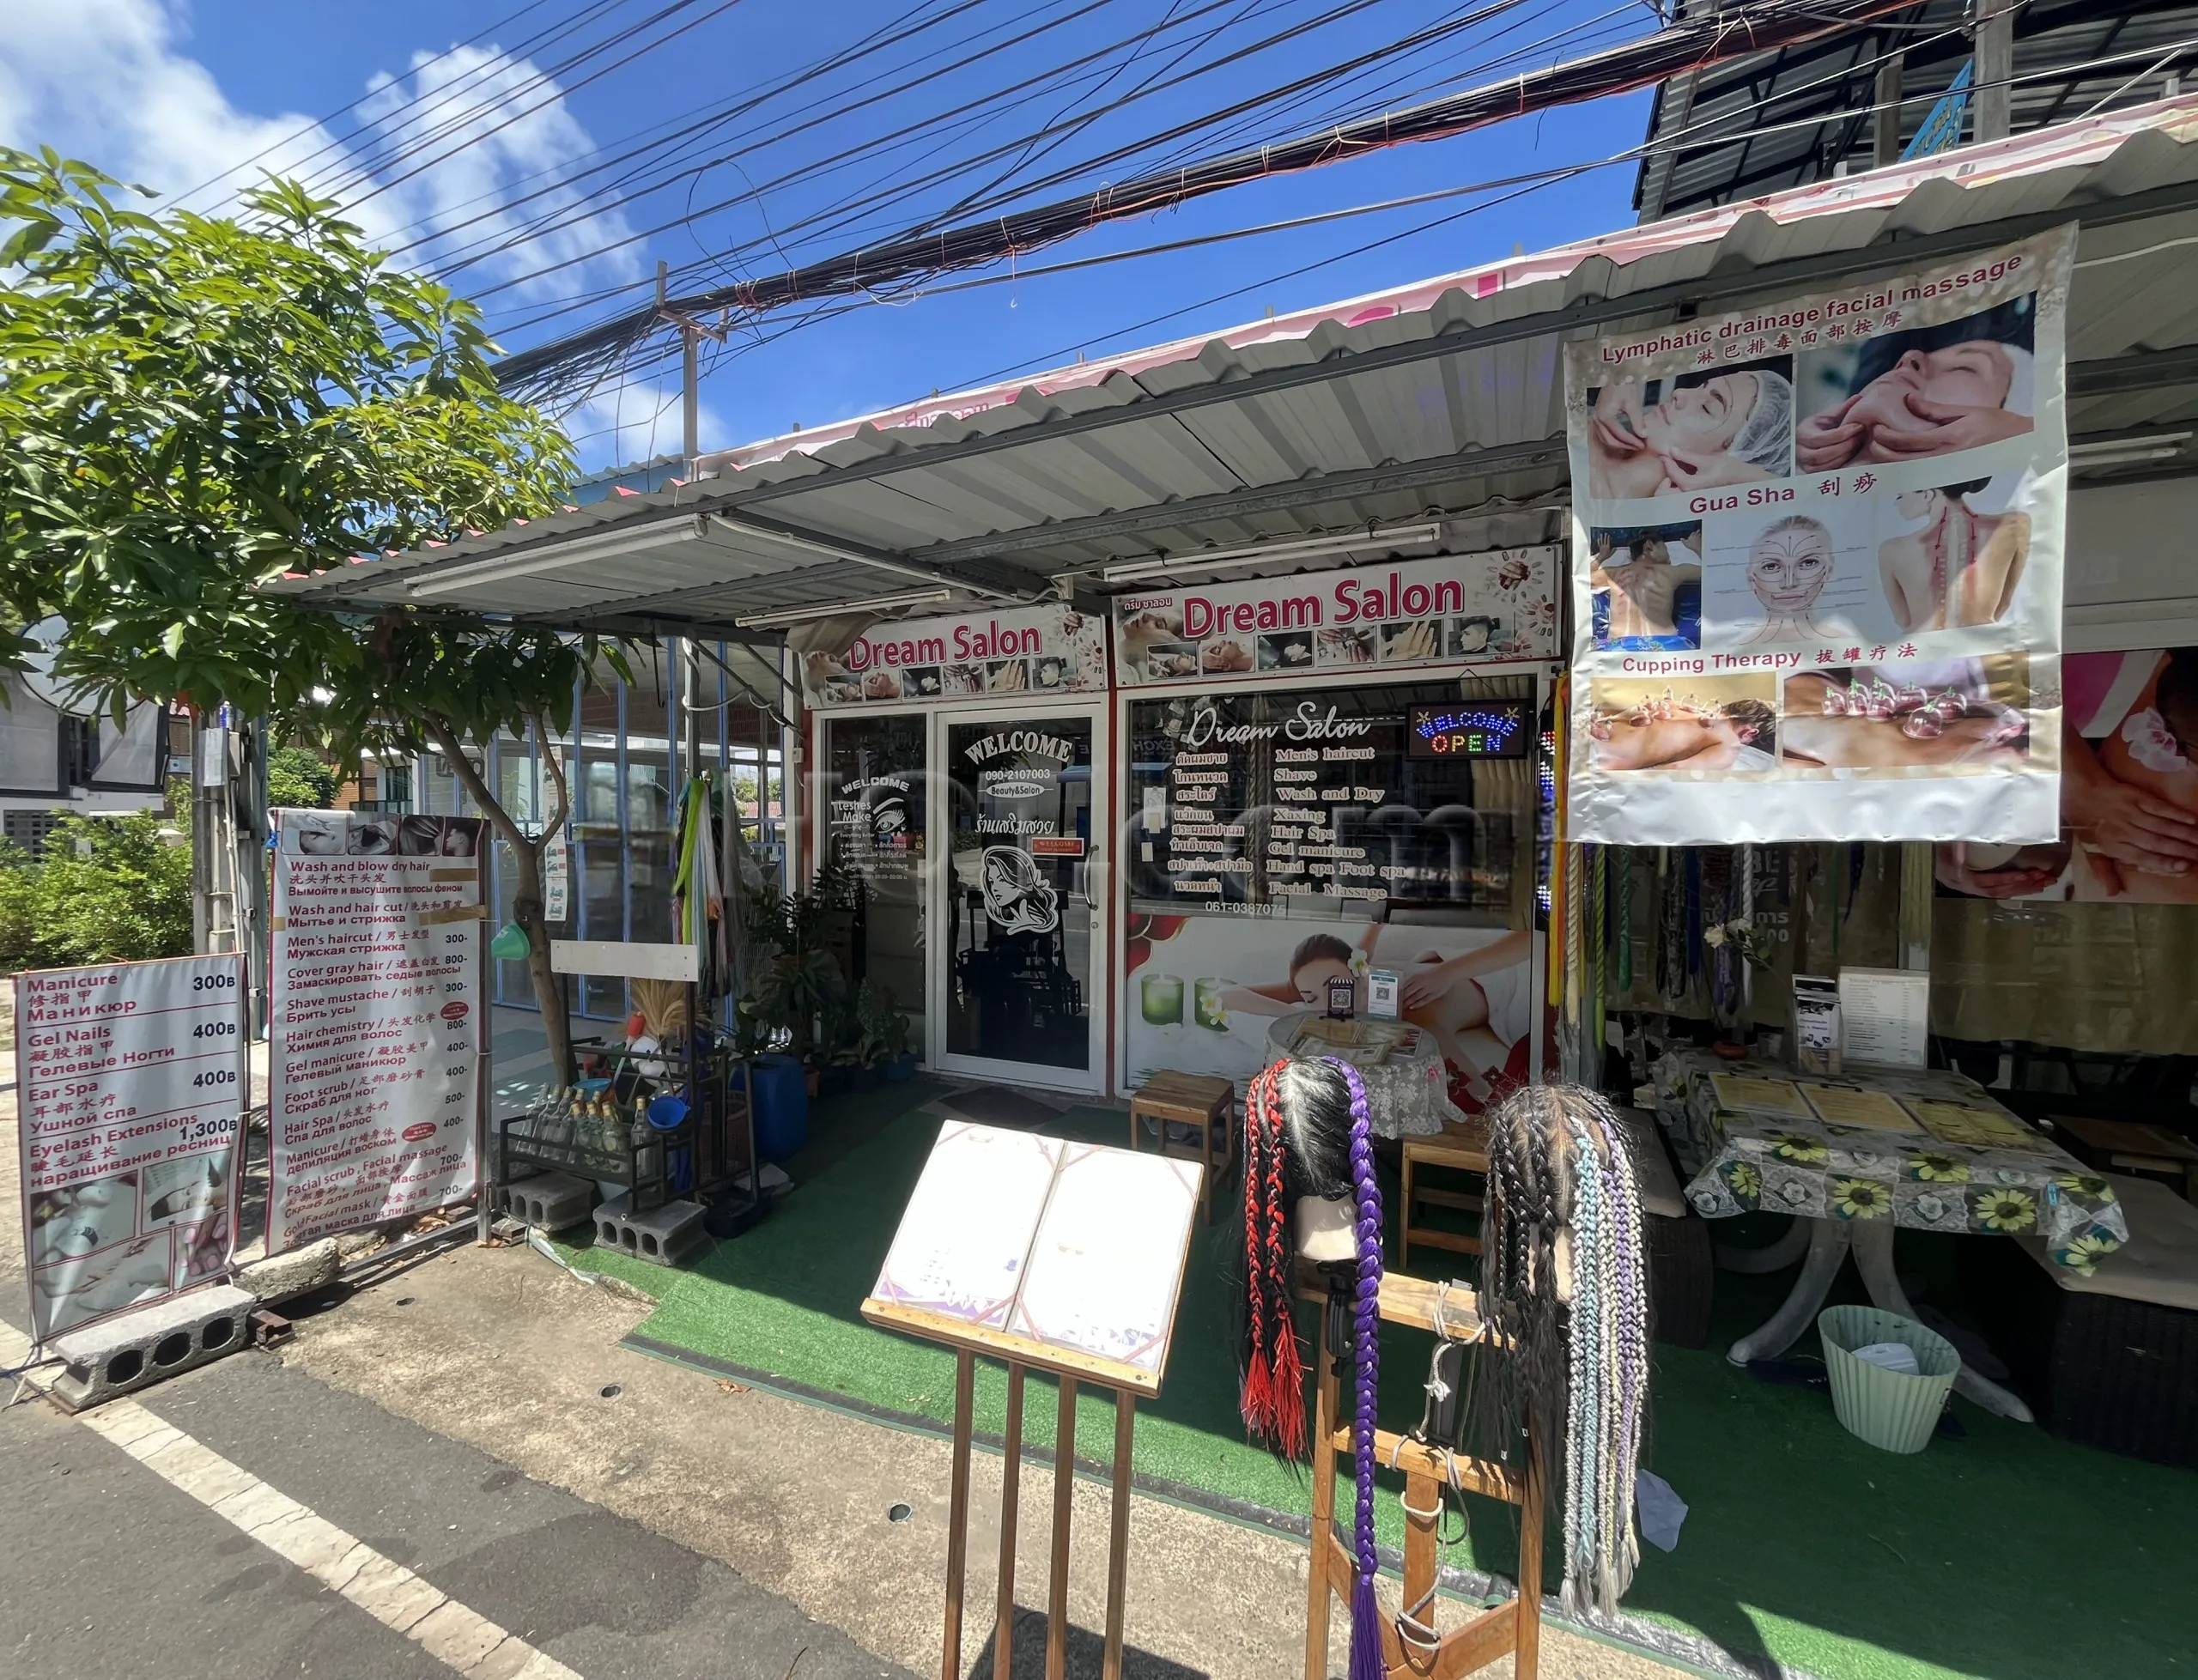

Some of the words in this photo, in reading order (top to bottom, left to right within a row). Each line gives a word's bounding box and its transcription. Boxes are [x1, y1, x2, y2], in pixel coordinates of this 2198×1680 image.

[1602, 326, 1713, 365] Lymphatic
[1719, 306, 1819, 344] drainage
[1826, 289, 1894, 318] facial
[1902, 256, 2021, 301] massage
[1697, 310, 1903, 365] 淋巴排毒面部按摩
[1817, 472, 1878, 497] 刮痧
[1689, 493, 1739, 515] Gua
[1746, 485, 1796, 509] Sha
[1124, 598, 1141, 611] ดรีม
[1143, 597, 1172, 610] ซาลอน
[1184, 592, 1322, 639] Dream
[1333, 572, 1464, 625] Salon
[850, 633, 945, 671] Dream
[953, 619, 1042, 661] Salon
[1814, 642, 1918, 664] 拔罐疗法
[1622, 654, 1704, 675] Cupping
[1711, 649, 1801, 672] Therapy
[1187, 707, 1278, 747] Dream
[1285, 701, 1371, 741] Salon
[1416, 711, 1519, 740] WELCOME
[965, 731, 1073, 765] WELCOME
[1431, 733, 1502, 754] OPEN
[1276, 749, 1318, 763] Men's
[1323, 746, 1375, 761] haircut
[985, 769, 1050, 781] 090-2107003
[1274, 768, 1317, 781] Shave
[841, 776, 910, 795] WELCOME
[991, 785, 1041, 797] Beauty&Salon
[1276, 787, 1317, 801] Wash
[1322, 786, 1350, 800] and
[1354, 787, 1385, 803] Dry
[838, 800, 871, 811] Leshes
[843, 811, 871, 822] Make
[975, 812, 1054, 834] ร้านเสริมสวย
[1273, 808, 1327, 824] Xaxing
[1271, 825, 1303, 839] Hair
[1308, 826, 1336, 842] Spa
[1268, 842, 1294, 855] Gel
[1298, 844, 1365, 858] manicure
[291, 862, 327, 872] Wash
[331, 861, 355, 871] and
[358, 861, 388, 871] blow
[392, 862, 408, 874] dry
[410, 862, 430, 871] hair
[1266, 859, 1305, 873] Hand
[1308, 864, 1336, 877] spa
[1339, 861, 1375, 876] Foot
[1379, 866, 1406, 880] spa
[289, 872, 386, 884] 洗头并吹干头发
[288, 886, 338, 896] Вымойте
[350, 886, 401, 895] высушите
[434, 884, 463, 894] феном
[1268, 882, 1312, 895] Facial
[1323, 883, 1387, 901] Massage
[289, 905, 325, 916] Wash
[328, 903, 352, 914] and
[355, 902, 379, 913] hair
[1205, 901, 1286, 914] 061-0387075
[288, 917, 335, 928] Мытье
[350, 914, 406, 925] стрижка
[288, 935, 325, 948] Men's
[328, 932, 373, 945] haircut
[446, 934, 468, 943] 300-
[288, 947, 345, 960] Мужская
[349, 943, 405, 955] стрижка
[445, 955, 468, 965] 800-
[288, 967, 324, 979] Cover
[327, 962, 354, 977] gray
[358, 961, 384, 972] hair
[288, 972, 382, 991] Замаскировать
[386, 969, 422, 980] седые
[426, 966, 461, 977] волосы
[27, 975, 118, 993] Manicure
[446, 982, 468, 992] 300-
[27, 990, 92, 1008] 修指甲
[287, 997, 325, 1011] Shave
[328, 988, 389, 1004] mustache
[287, 1010, 327, 1023] Брить
[331, 1005, 356, 1019] усы
[286, 1030, 313, 1043] Hair
[316, 1020, 375, 1038] chemistry
[446, 1020, 467, 1030] 800-
[28, 1031, 60, 1046] Gel
[67, 1026, 111, 1043] Nails
[287, 1040, 330, 1054] Химия
[333, 1035, 356, 1047] для
[361, 1029, 403, 1041] волос
[446, 1042, 469, 1052] 400-
[29, 1056, 116, 1079] Гелевые
[123, 1046, 174, 1064] Ногти
[285, 1064, 342, 1084] Гелевый
[345, 1056, 407, 1072] маникюр
[286, 1060, 307, 1074] Gel
[311, 1050, 366, 1070] manicure
[446, 1066, 468, 1077] 400-
[29, 1088, 60, 1102] Ear
[64, 1082, 99, 1097] Spa
[284, 1089, 314, 1105] Foot
[318, 1081, 349, 1097] scrub
[285, 1097, 326, 1115] Скраб
[329, 1093, 352, 1107] для
[355, 1087, 378, 1099] ног
[445, 1094, 465, 1105] 500-
[33, 1093, 116, 1119] 耳部水疗
[30, 1111, 97, 1134] Ушной
[104, 1107, 137, 1120] спа
[284, 1120, 310, 1135] Hair
[313, 1115, 334, 1130] Spa
[284, 1131, 309, 1145] Спа
[312, 1126, 335, 1140] для
[339, 1115, 373, 1131] волос
[443, 1118, 464, 1129] 400-
[30, 1129, 102, 1158] Eyelash
[107, 1114, 197, 1142] Extensions
[30, 1151, 162, 1187] наращивание
[167, 1135, 231, 1158] ресниц
[286, 1142, 339, 1165] Manicure
[287, 1149, 351, 1177] депиляция
[355, 1137, 397, 1154] воском
[440, 1153, 463, 1166] 700-
[286, 1180, 321, 1197] Facial
[363, 1155, 396, 1170] Facial
[399, 1143, 447, 1162] massage
[325, 1193, 349, 1207] для
[390, 1168, 437, 1186] Массаж
[439, 1161, 466, 1176] лица
[340, 1198, 371, 1214] mask
[325, 1215, 360, 1230] маска
[361, 1209, 385, 1223] для
[387, 1204, 416, 1217] лица
